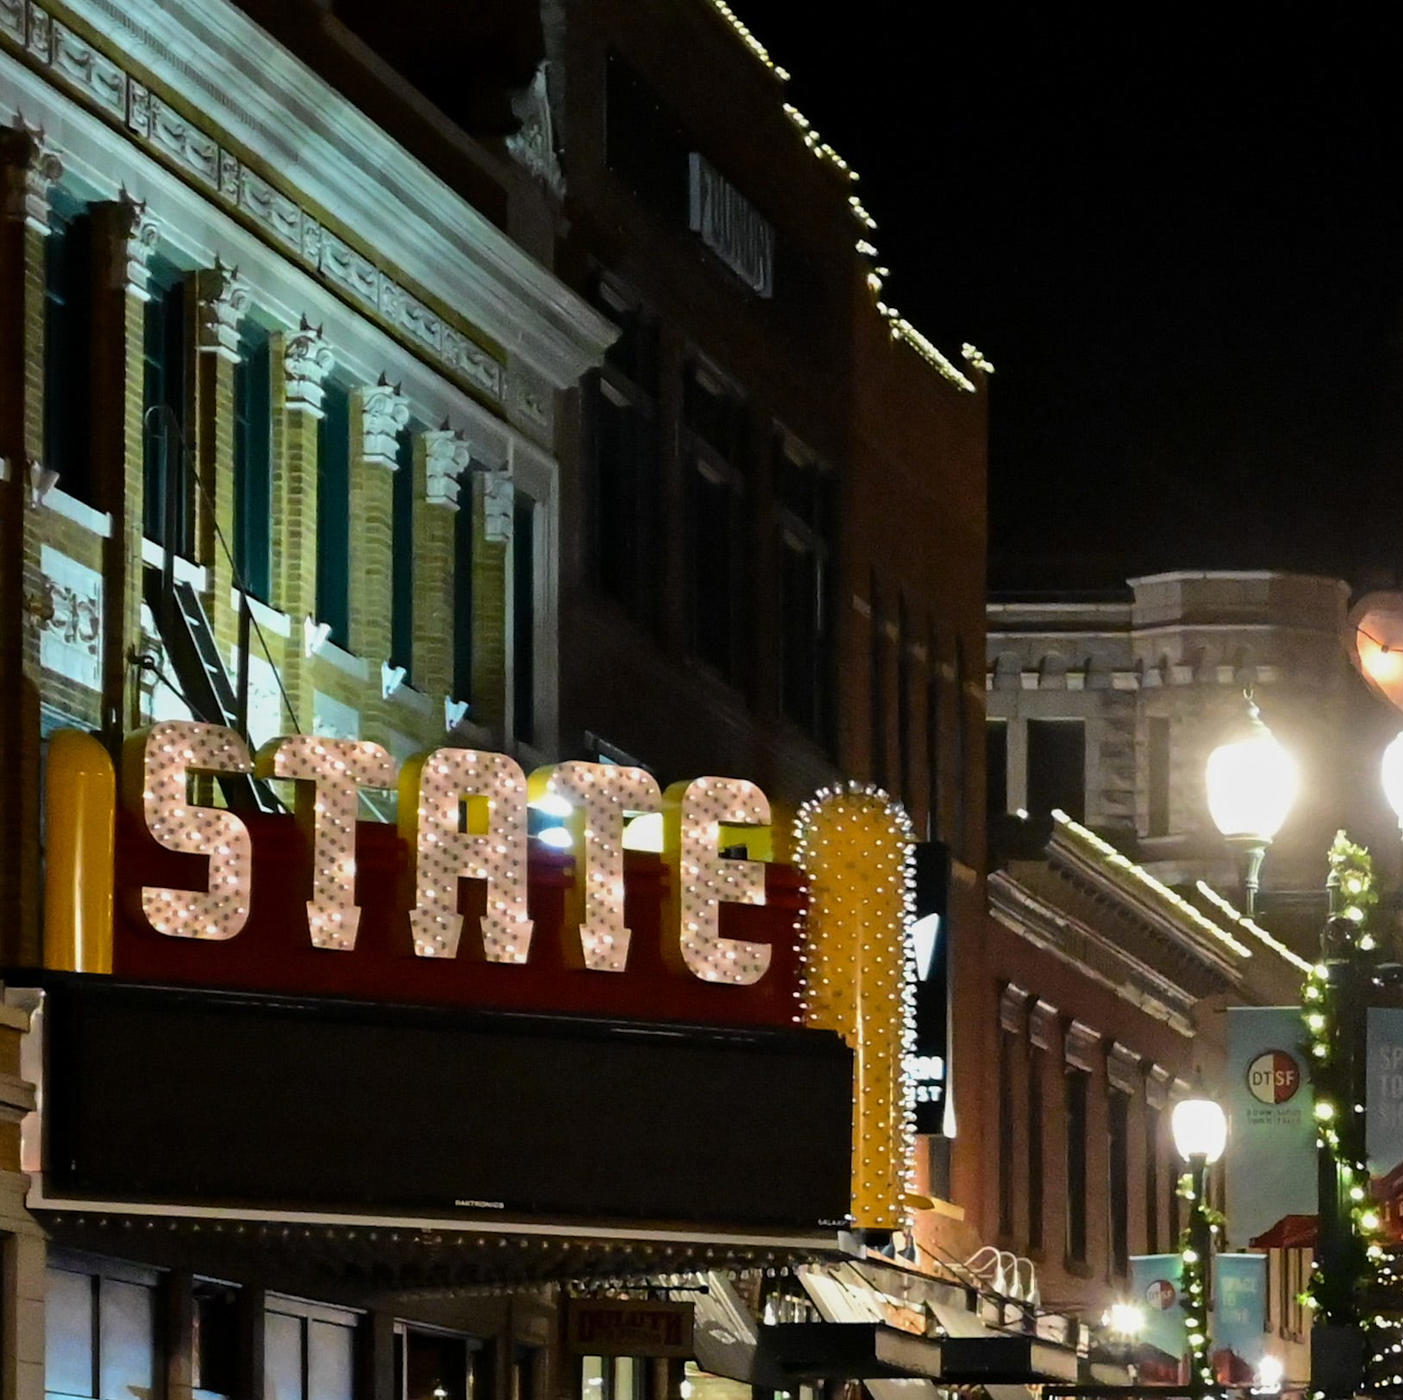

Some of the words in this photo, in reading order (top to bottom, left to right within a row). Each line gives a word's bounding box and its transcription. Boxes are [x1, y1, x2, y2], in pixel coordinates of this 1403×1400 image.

[140, 719, 774, 987] STATE
[1252, 1070, 1295, 1087] DTSF
[1381, 1074, 1403, 1099] TO
